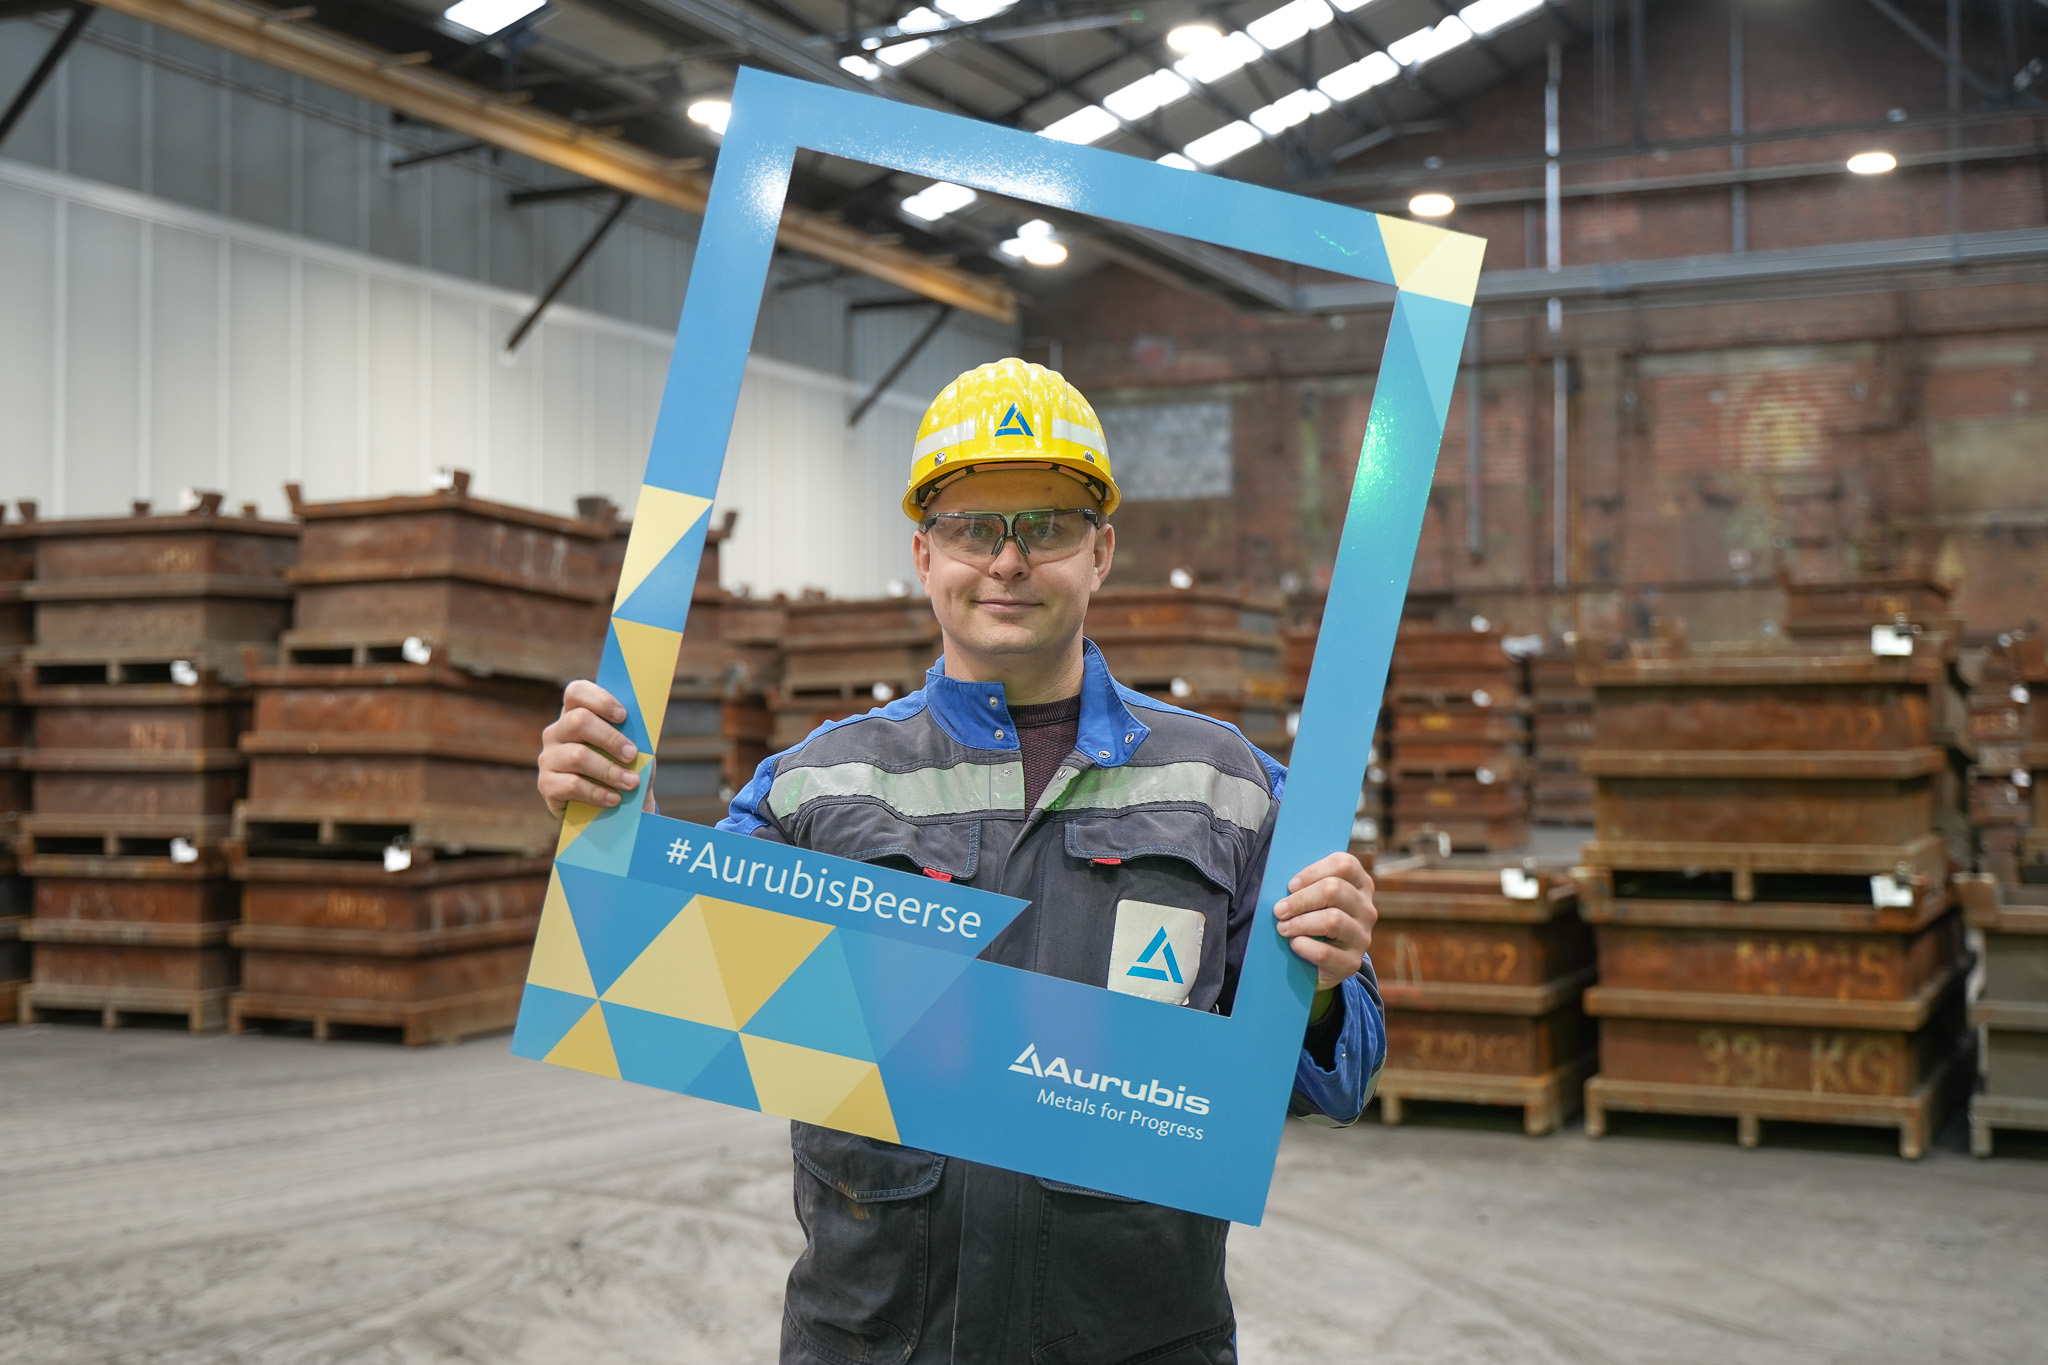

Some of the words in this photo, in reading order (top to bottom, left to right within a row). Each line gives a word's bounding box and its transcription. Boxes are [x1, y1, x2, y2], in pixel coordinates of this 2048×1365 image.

[666, 837, 982, 939] #AurubisBeerse
[1036, 1088, 1096, 1116] Metals
[1100, 1102, 1126, 1122] for
[1130, 1110, 1205, 1141] Progress
[1043, 1056, 1210, 1116] Aurubis
